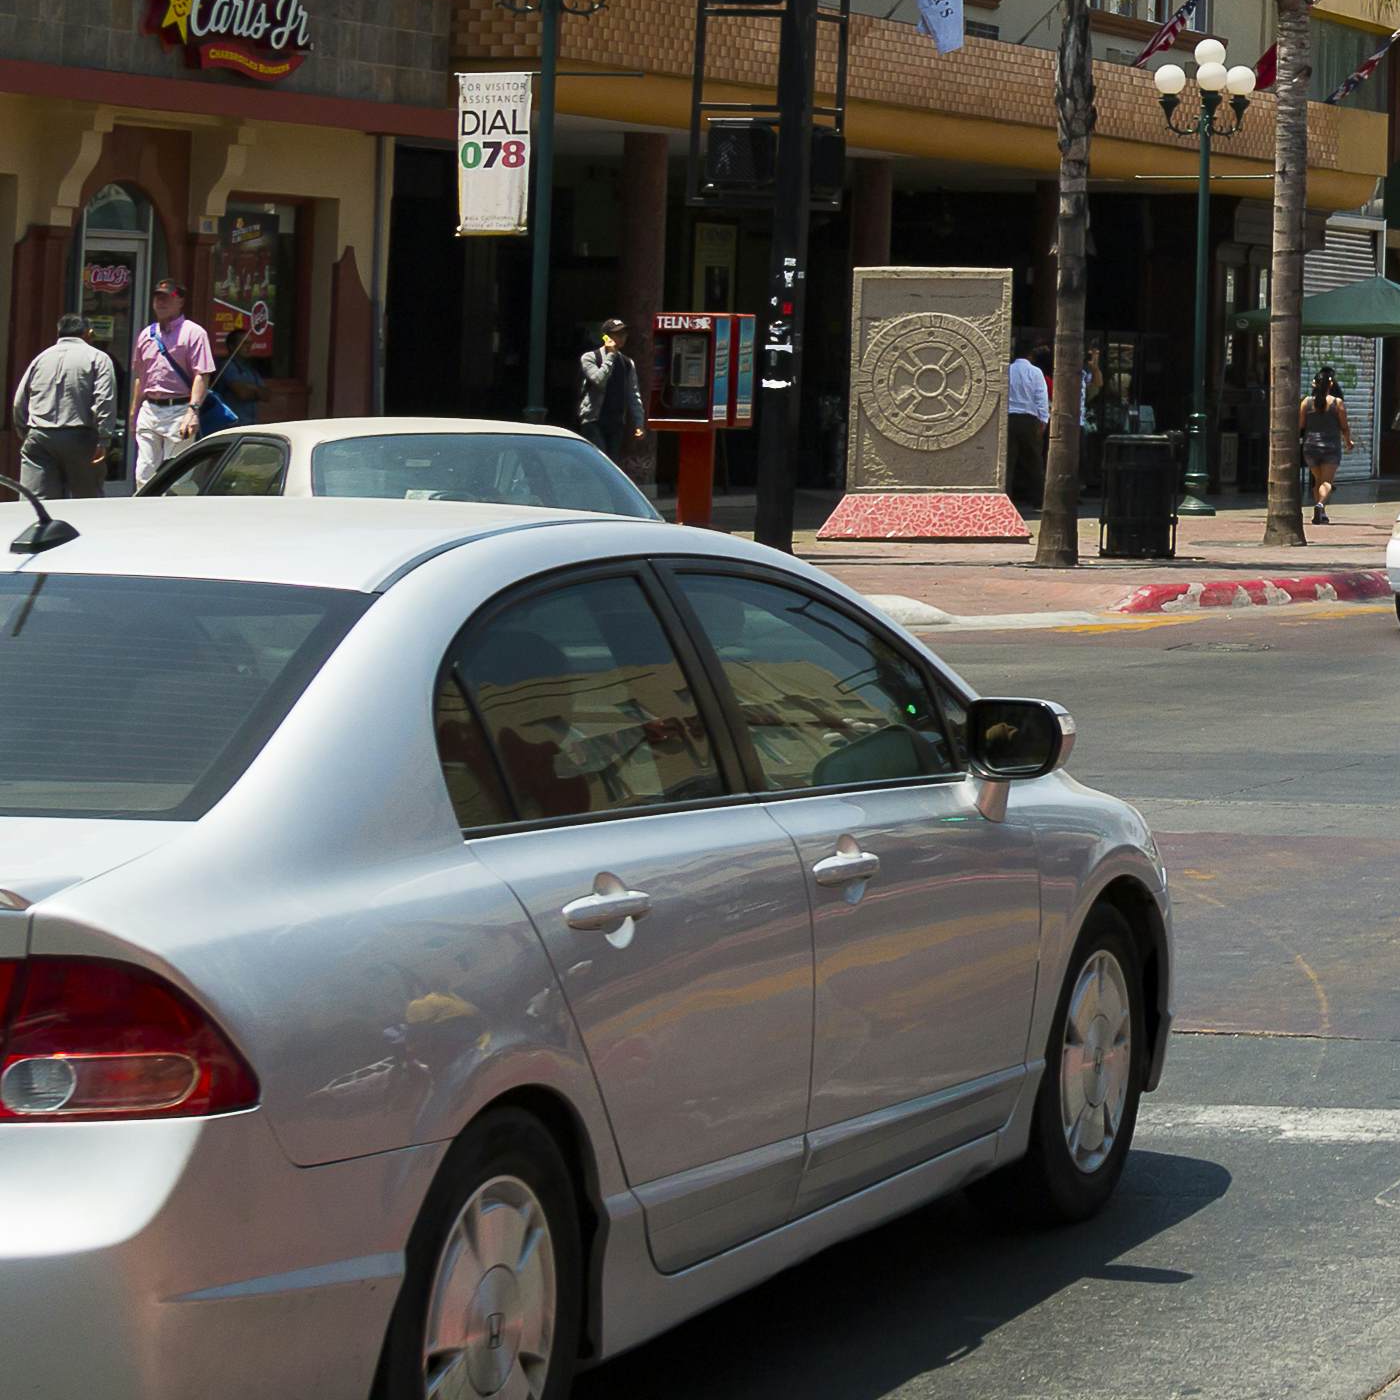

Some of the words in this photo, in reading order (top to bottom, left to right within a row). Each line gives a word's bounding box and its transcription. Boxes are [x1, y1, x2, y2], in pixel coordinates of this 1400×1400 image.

[460, 83, 481, 92] FOR
[485, 81, 527, 92] VISITOR
[462, 93, 526, 105] ASSISTANCE
[461, 110, 529, 136] DIAL
[461, 140, 526, 169] 078
